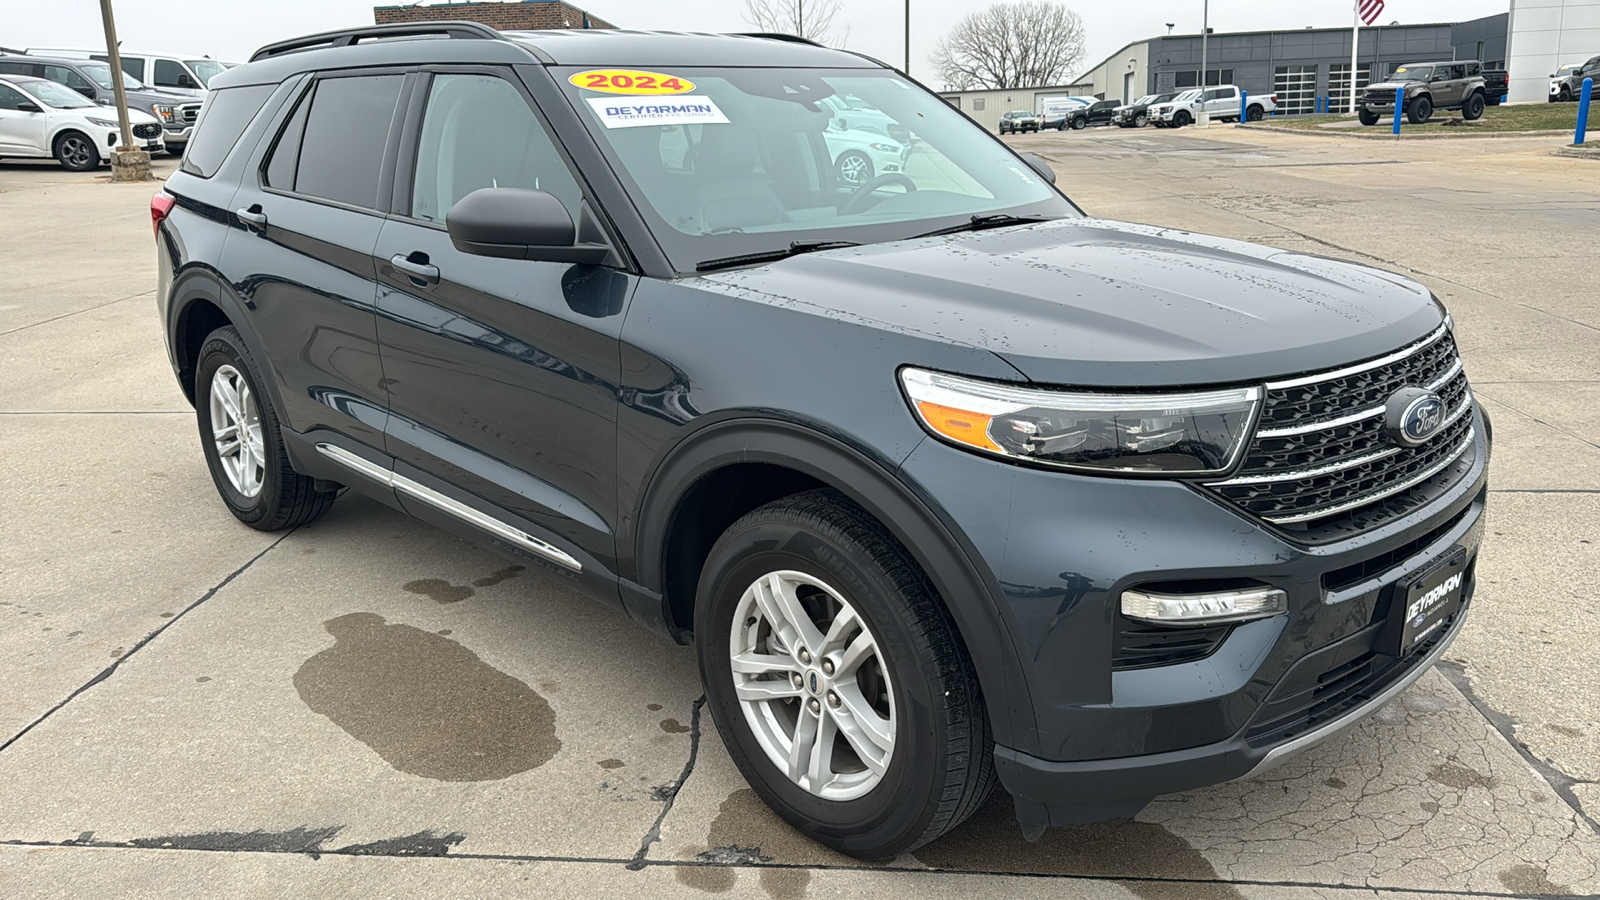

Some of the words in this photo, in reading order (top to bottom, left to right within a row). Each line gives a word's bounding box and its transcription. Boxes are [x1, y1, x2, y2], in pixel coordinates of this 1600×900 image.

[585, 74, 684, 91] 2024
[605, 104, 711, 116] DEYARMAN
[1415, 404, 1441, 434] Ford
[1406, 571, 1463, 624] DEYARMAN
